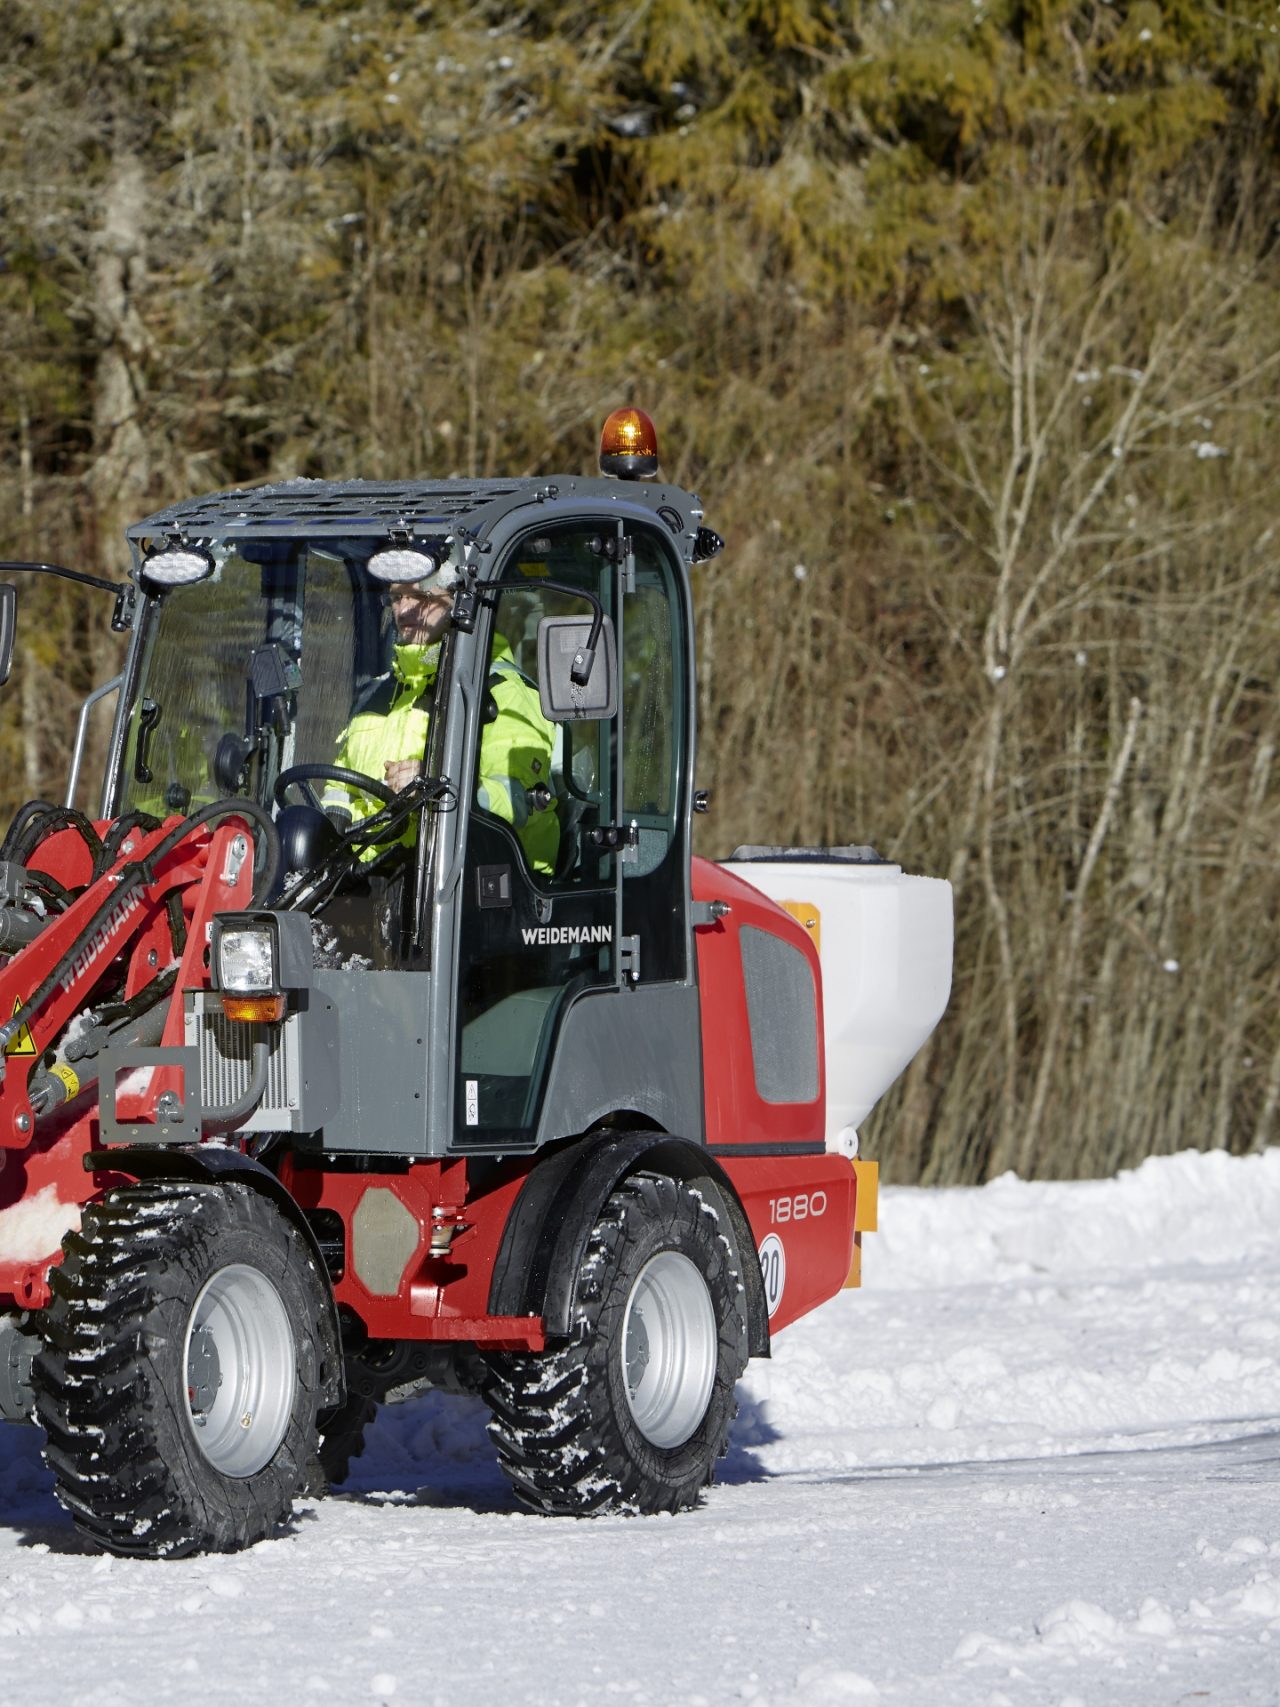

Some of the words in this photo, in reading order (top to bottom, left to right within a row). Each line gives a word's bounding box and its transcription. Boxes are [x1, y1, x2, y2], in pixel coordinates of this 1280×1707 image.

[60, 886, 145, 994] WEIDEMANN
[521, 925, 612, 945] WEIDEMANN
[769, 1190, 827, 1225] 1880
